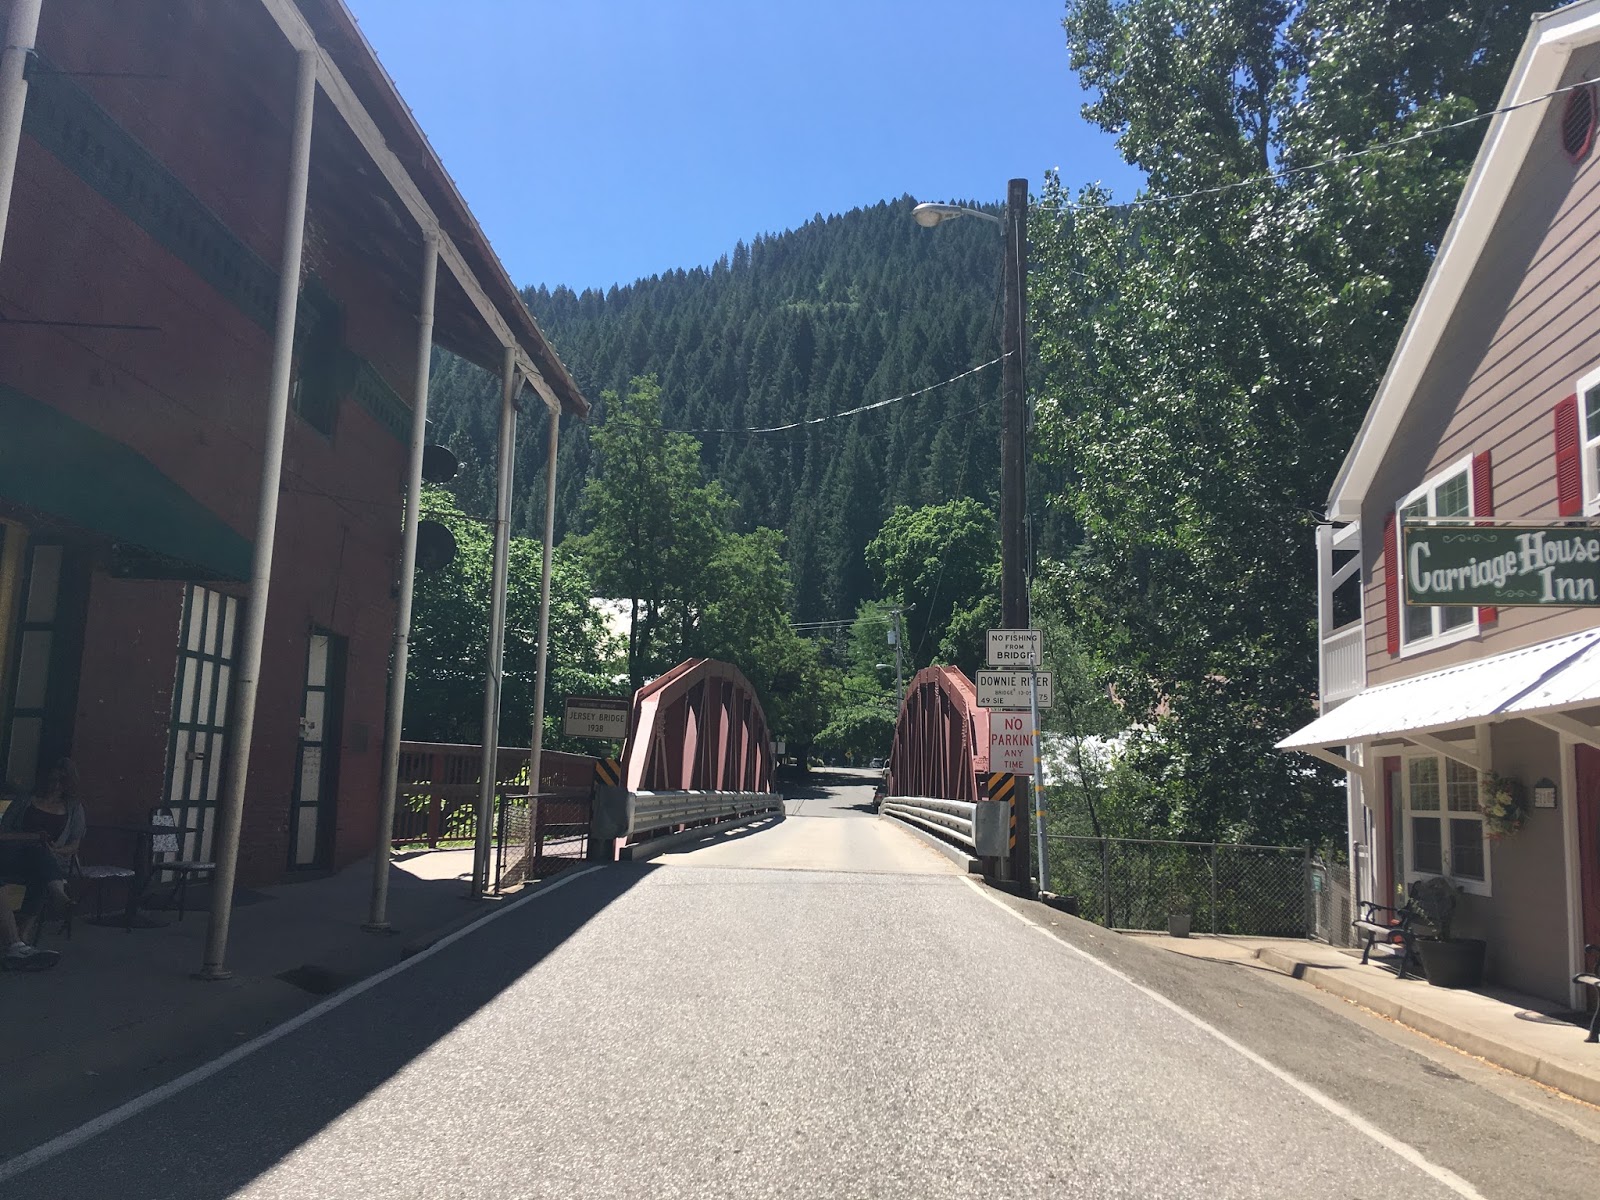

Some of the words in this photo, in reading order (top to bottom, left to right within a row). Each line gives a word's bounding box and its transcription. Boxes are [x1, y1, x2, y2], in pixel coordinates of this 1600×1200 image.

[1409, 542, 1517, 594] Carriage
[1515, 531, 1600, 576] House
[1538, 566, 1598, 602] Inn
[980, 676, 1016, 686] DOWNIE
[1020, 676, 1048, 686] RIER
[569, 711, 596, 721] JERSEY
[599, 713, 625, 723] BRIDGE
[587, 724, 604, 733] 1938
[1005, 718, 1023, 730] NO
[1004, 749, 1024, 757] ANY
[1004, 760, 1024, 768] TIME
